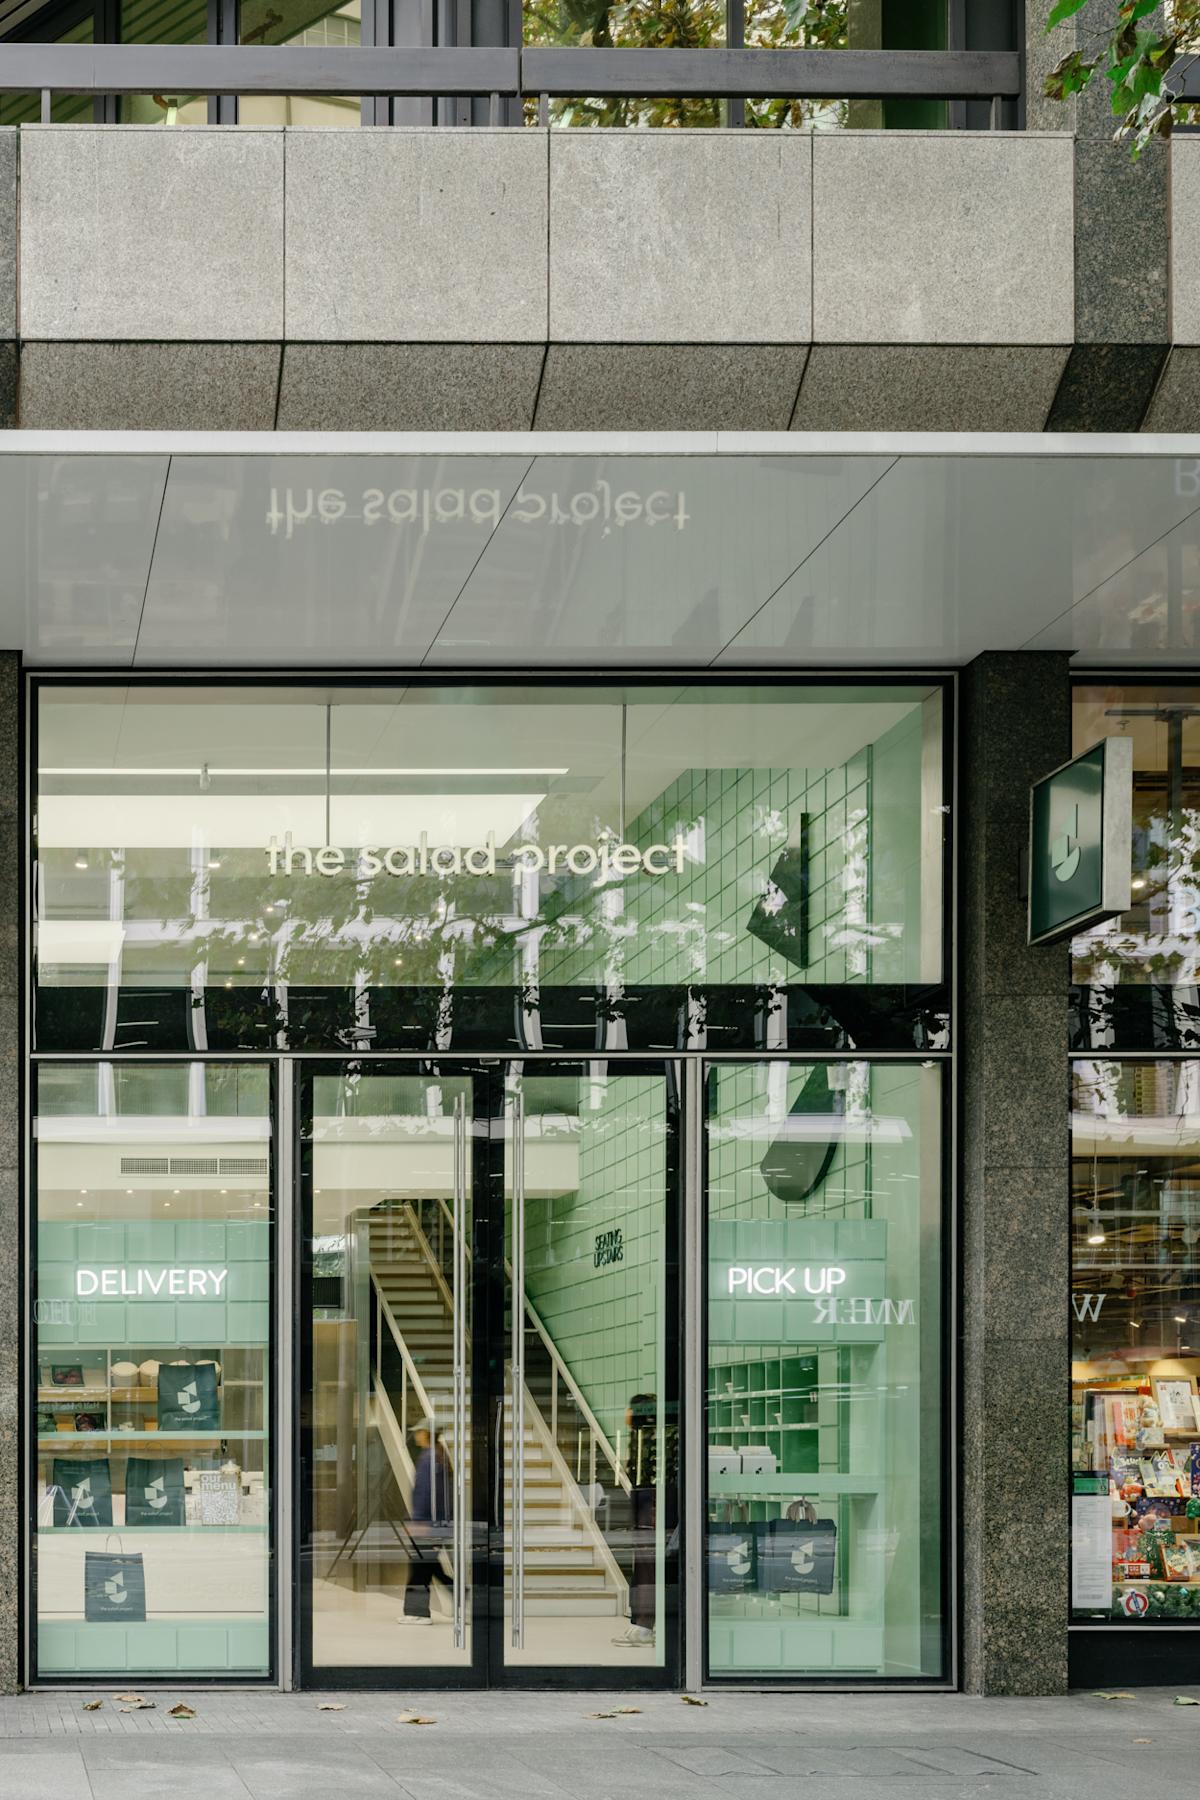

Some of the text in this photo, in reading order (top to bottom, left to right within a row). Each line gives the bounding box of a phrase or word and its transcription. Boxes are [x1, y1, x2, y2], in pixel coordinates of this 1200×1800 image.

[265, 830, 690, 888] the salad project
[76, 1268, 228, 1296] DELIVERY
[727, 1267, 847, 1294] PICK UP
[200, 1474, 221, 1483] our
[200, 1482, 237, 1491] menu
